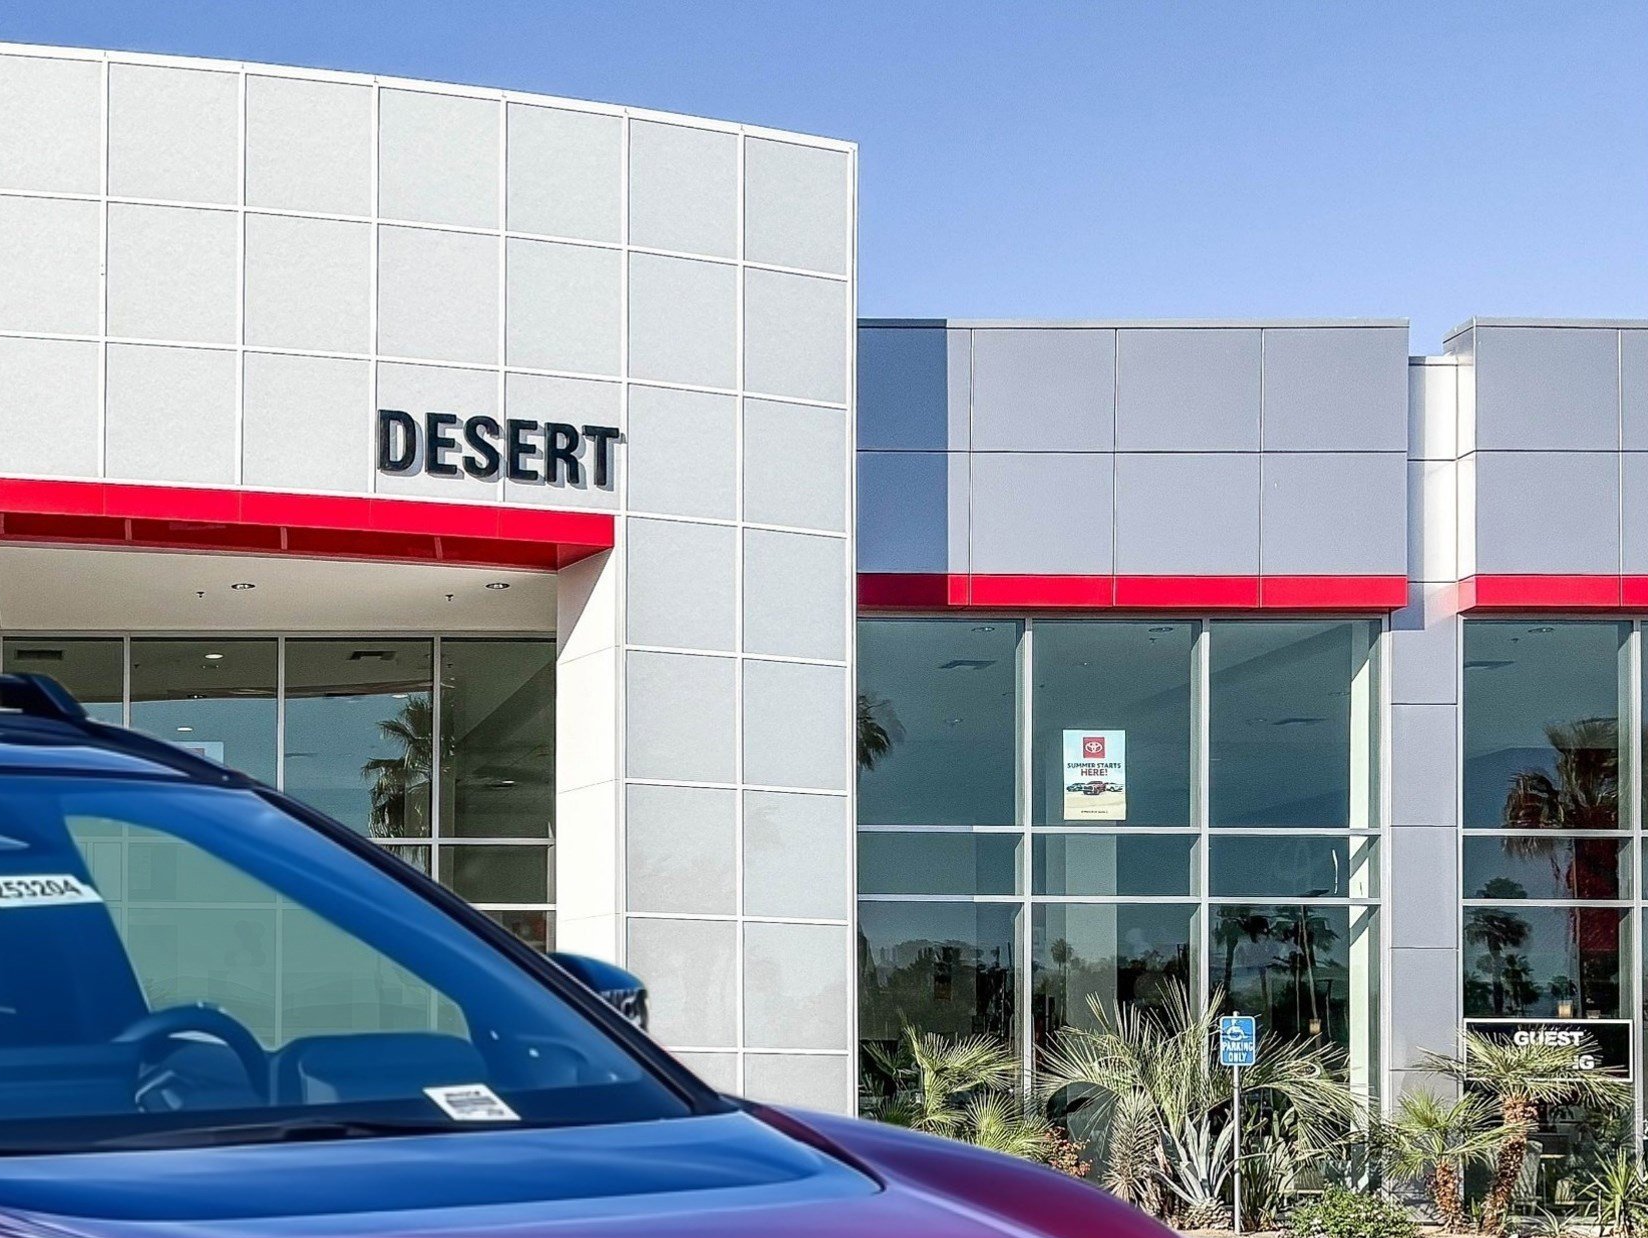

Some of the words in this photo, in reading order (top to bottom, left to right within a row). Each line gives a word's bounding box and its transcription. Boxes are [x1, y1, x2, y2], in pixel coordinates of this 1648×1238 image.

[377, 409, 620, 487] DESERT
[1513, 1031, 1584, 1046] GUEST
[1222, 1041, 1253, 1052] PARKING
[1228, 1052, 1248, 1062] ONLY
